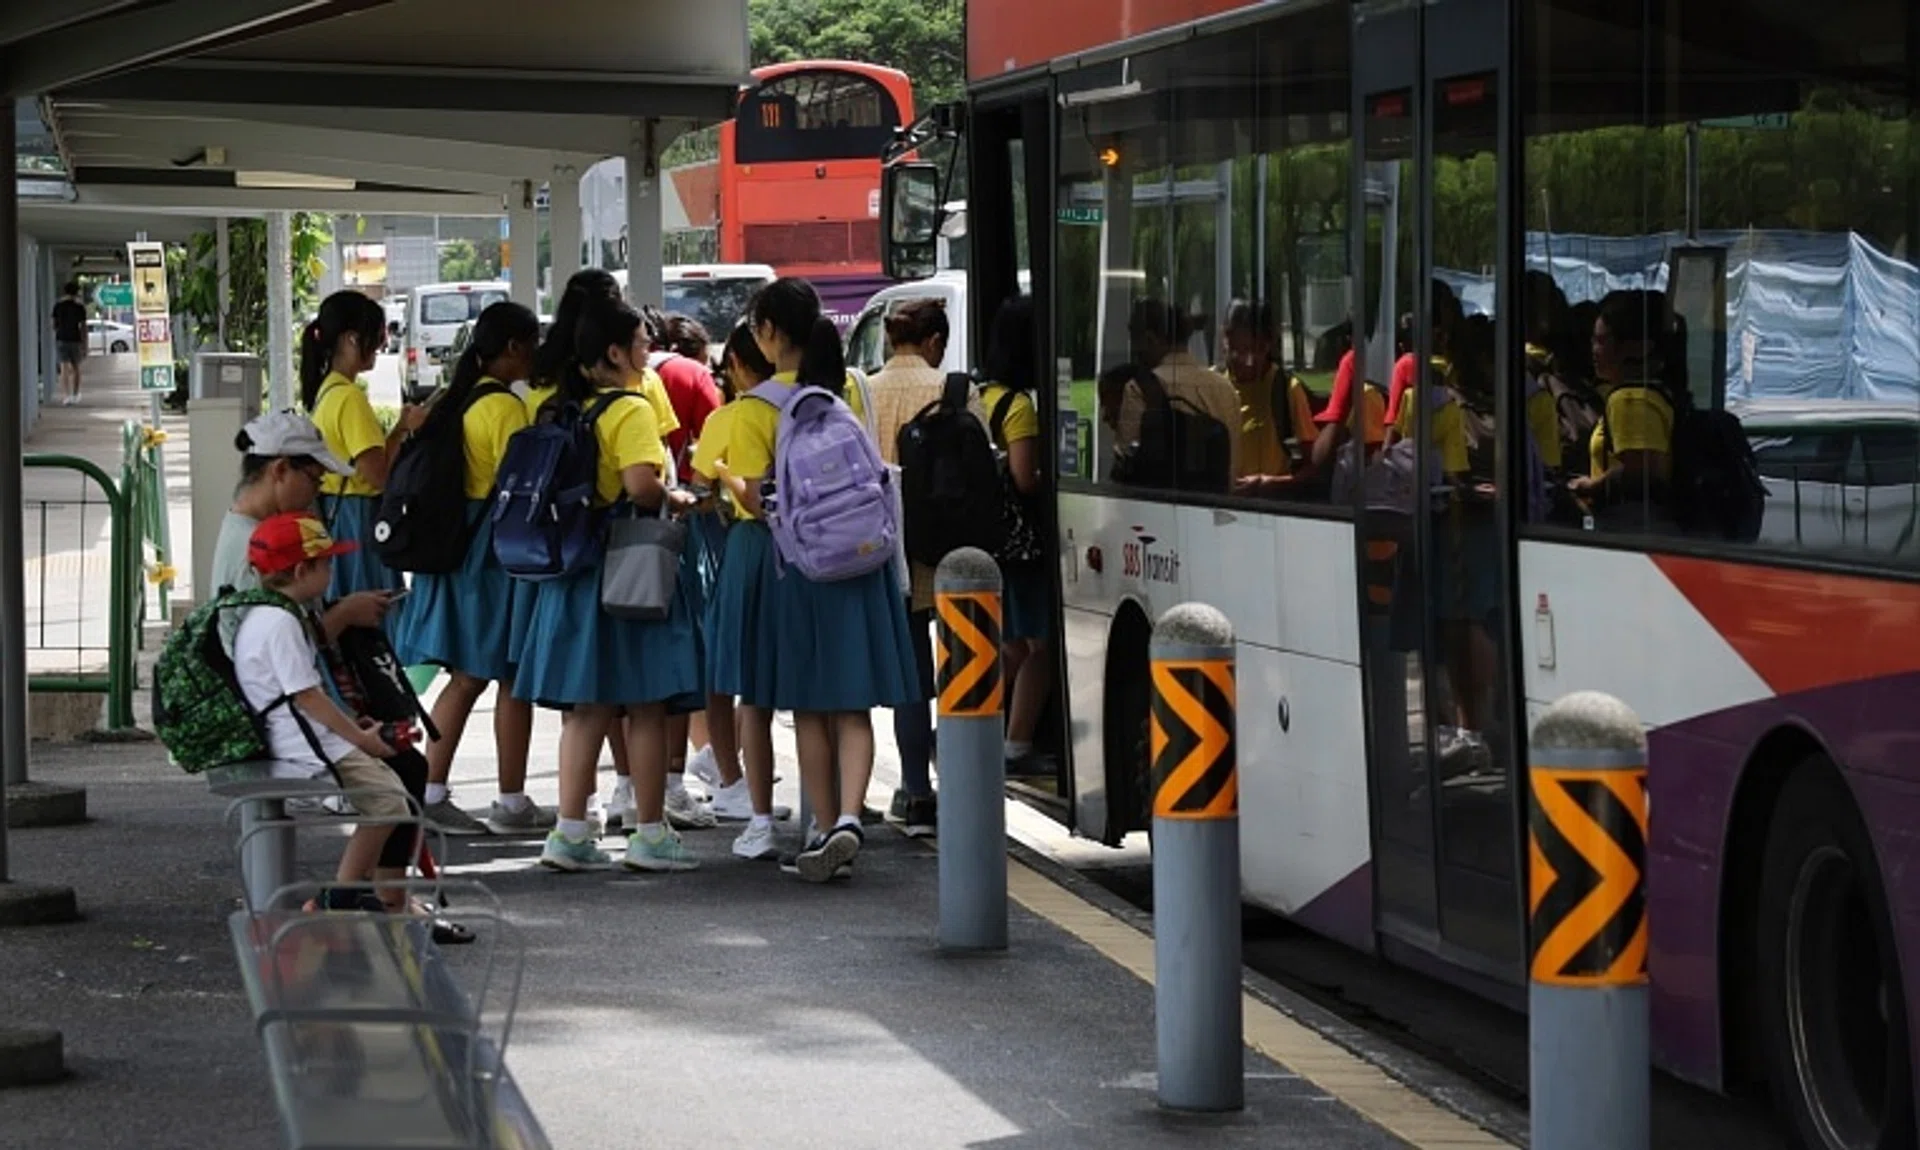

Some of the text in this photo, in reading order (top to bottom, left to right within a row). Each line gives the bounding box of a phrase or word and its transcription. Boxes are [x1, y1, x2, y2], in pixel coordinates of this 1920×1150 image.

[762, 102, 780, 128] 111
[1123, 536, 1180, 585] SBS Transit
